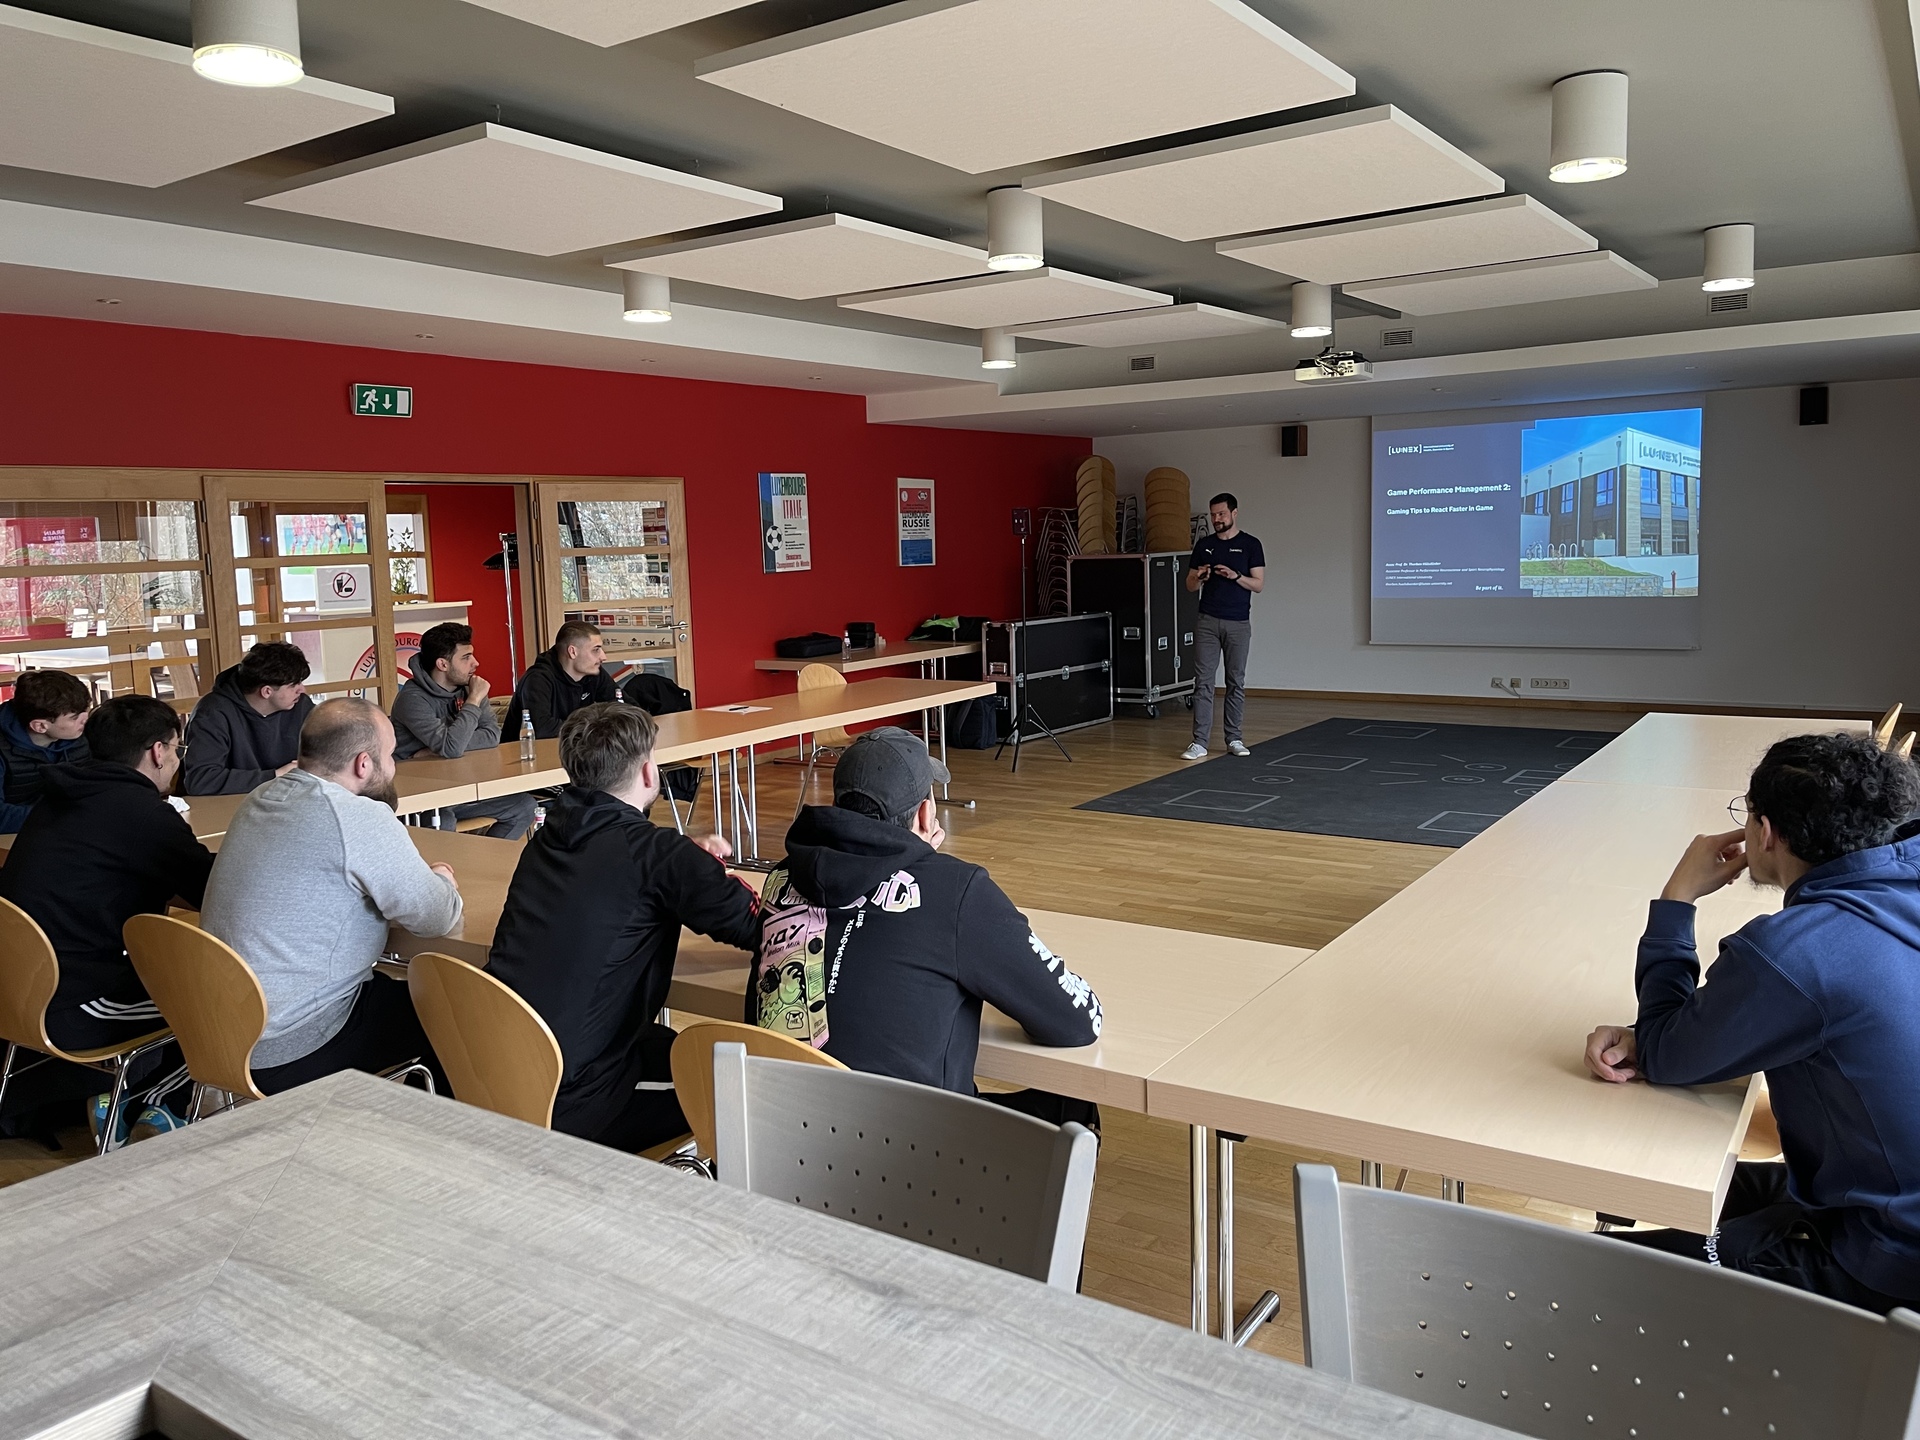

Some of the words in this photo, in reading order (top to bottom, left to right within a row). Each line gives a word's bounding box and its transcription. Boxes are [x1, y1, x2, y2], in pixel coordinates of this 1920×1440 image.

[771, 476, 806, 496] LUXEMBOURG
[1387, 489, 1408, 497] Game
[1409, 486, 1454, 495] Performance
[1454, 484, 1502, 494] Management
[1503, 483, 1511, 491] 2:
[783, 499, 802, 519] ITALIE
[1387, 508, 1410, 516] Gaming
[1410, 507, 1423, 515] Tips
[1449, 505, 1468, 513] Faster
[902, 519, 930, 528] RUSSIE
